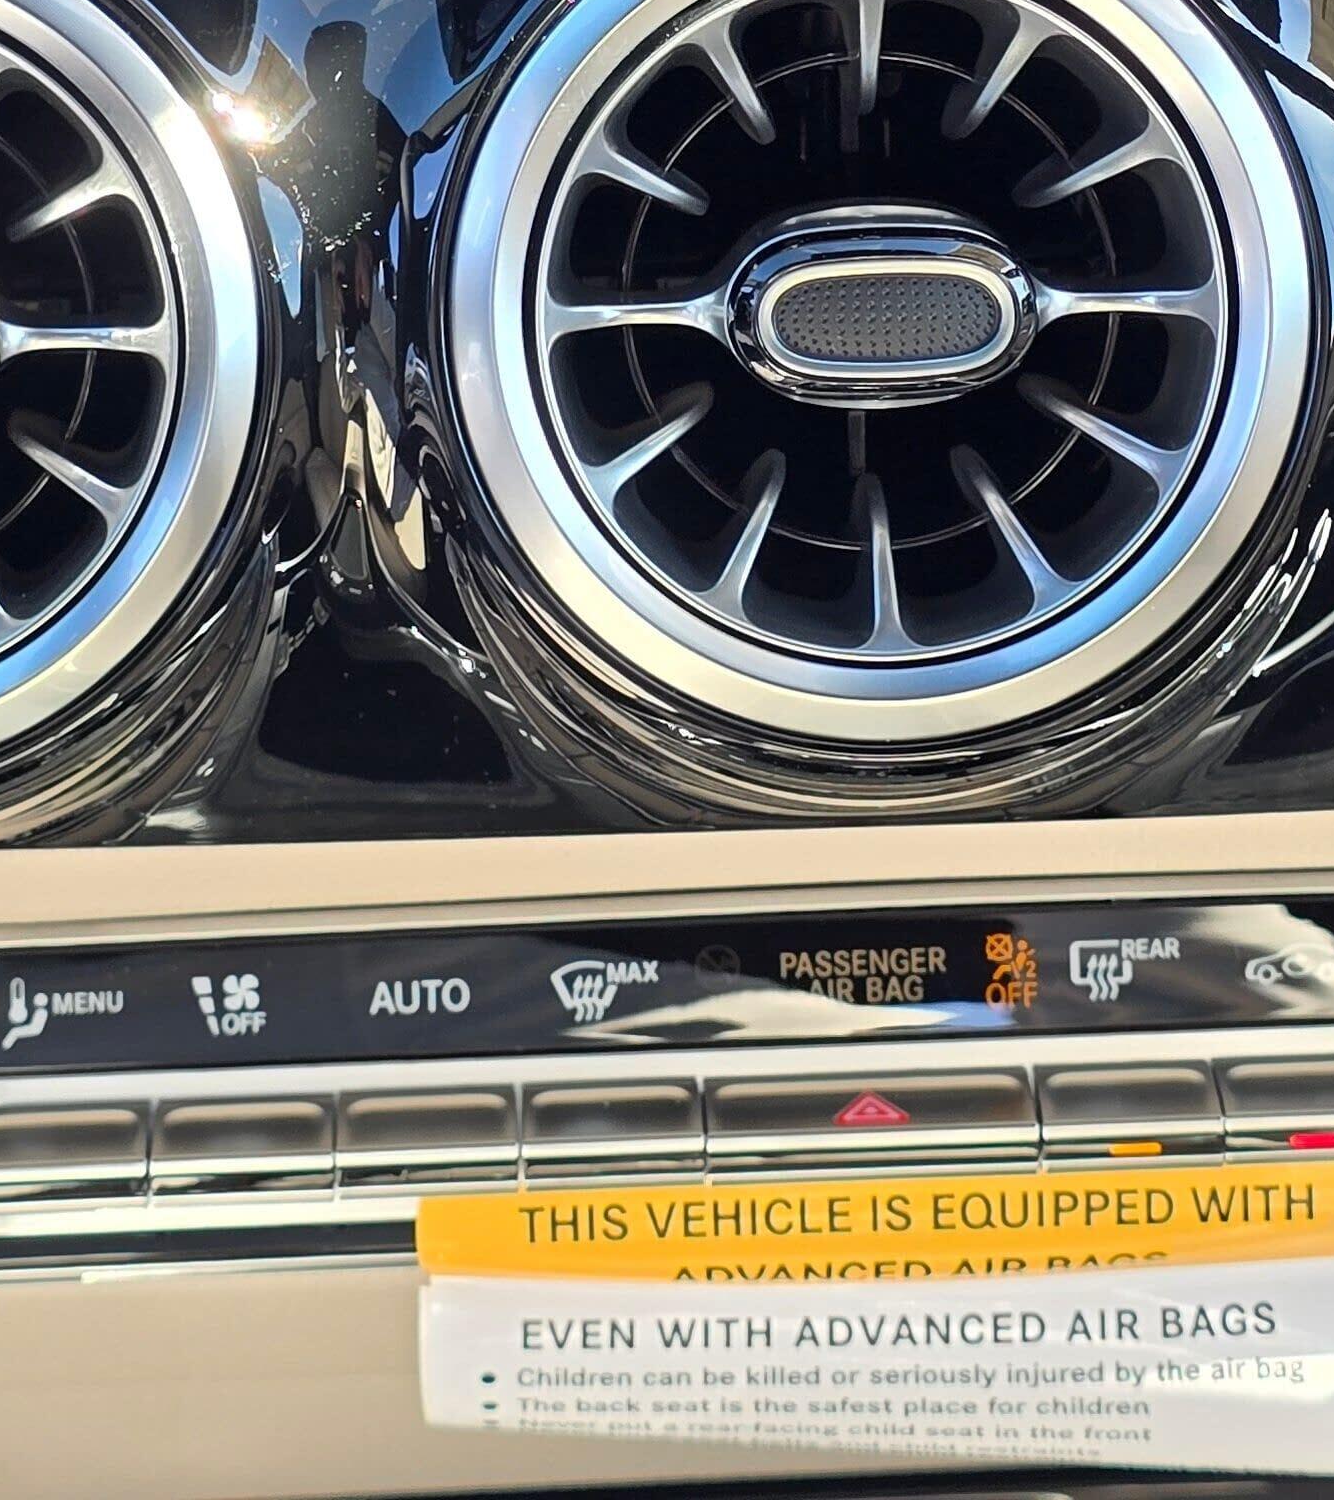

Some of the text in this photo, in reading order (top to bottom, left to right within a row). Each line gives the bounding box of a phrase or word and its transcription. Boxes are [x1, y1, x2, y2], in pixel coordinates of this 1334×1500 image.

[779, 946, 947, 980] PASSENGER
[1120, 937, 1181, 961] REAR
[606, 959, 659, 985] MAX
[51, 989, 124, 1016] MENU
[369, 977, 471, 1016] AUTO
[809, 974, 925, 1004] AIR BAG
[985, 980, 1039, 1010] OFF
[220, 1011, 267, 1036] OFF
[518, 1182, 1315, 1243] THIS VEHICLE IS EQUIPPED WITH
[521, 1301, 1279, 1350] EVEN WITH ADVANCED AIR BAGS
[517, 1354, 1305, 1389] Children can be killed or seriously injured by the air bag
[516, 1396, 1151, 1419] The back seat is the safest place for children
[1029, 1424, 1075, 1441] the
[1083, 1426, 1153, 1442] front
